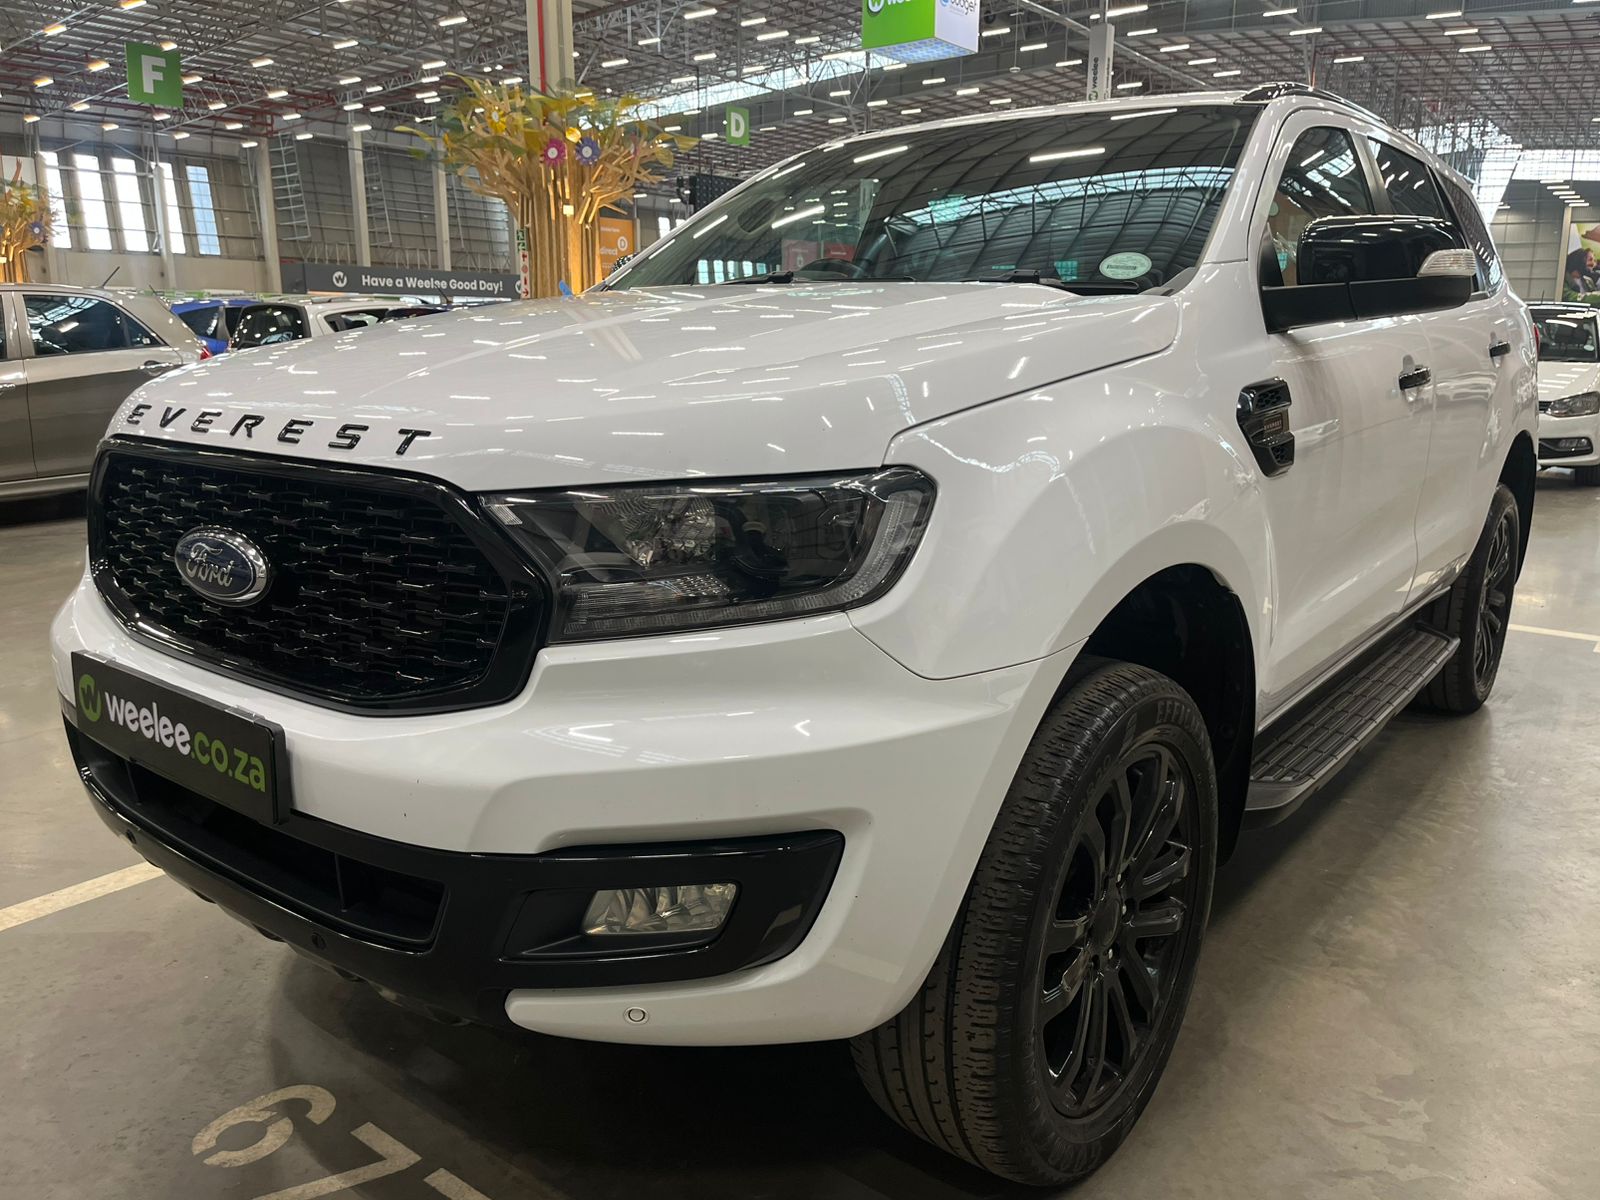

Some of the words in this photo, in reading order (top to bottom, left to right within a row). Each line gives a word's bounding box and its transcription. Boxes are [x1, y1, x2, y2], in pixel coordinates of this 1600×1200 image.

[141, 54, 167, 94] F
[730, 111, 745, 138] D
[361, 274, 393, 288] Have
[395, 278, 403, 288] a
[450, 279, 477, 291] Good
[479, 281, 503, 294] Day!
[126, 403, 432, 456] EVEREST
[185, 541, 235, 588] Ford
[104, 691, 266, 793] weelee.co.za
